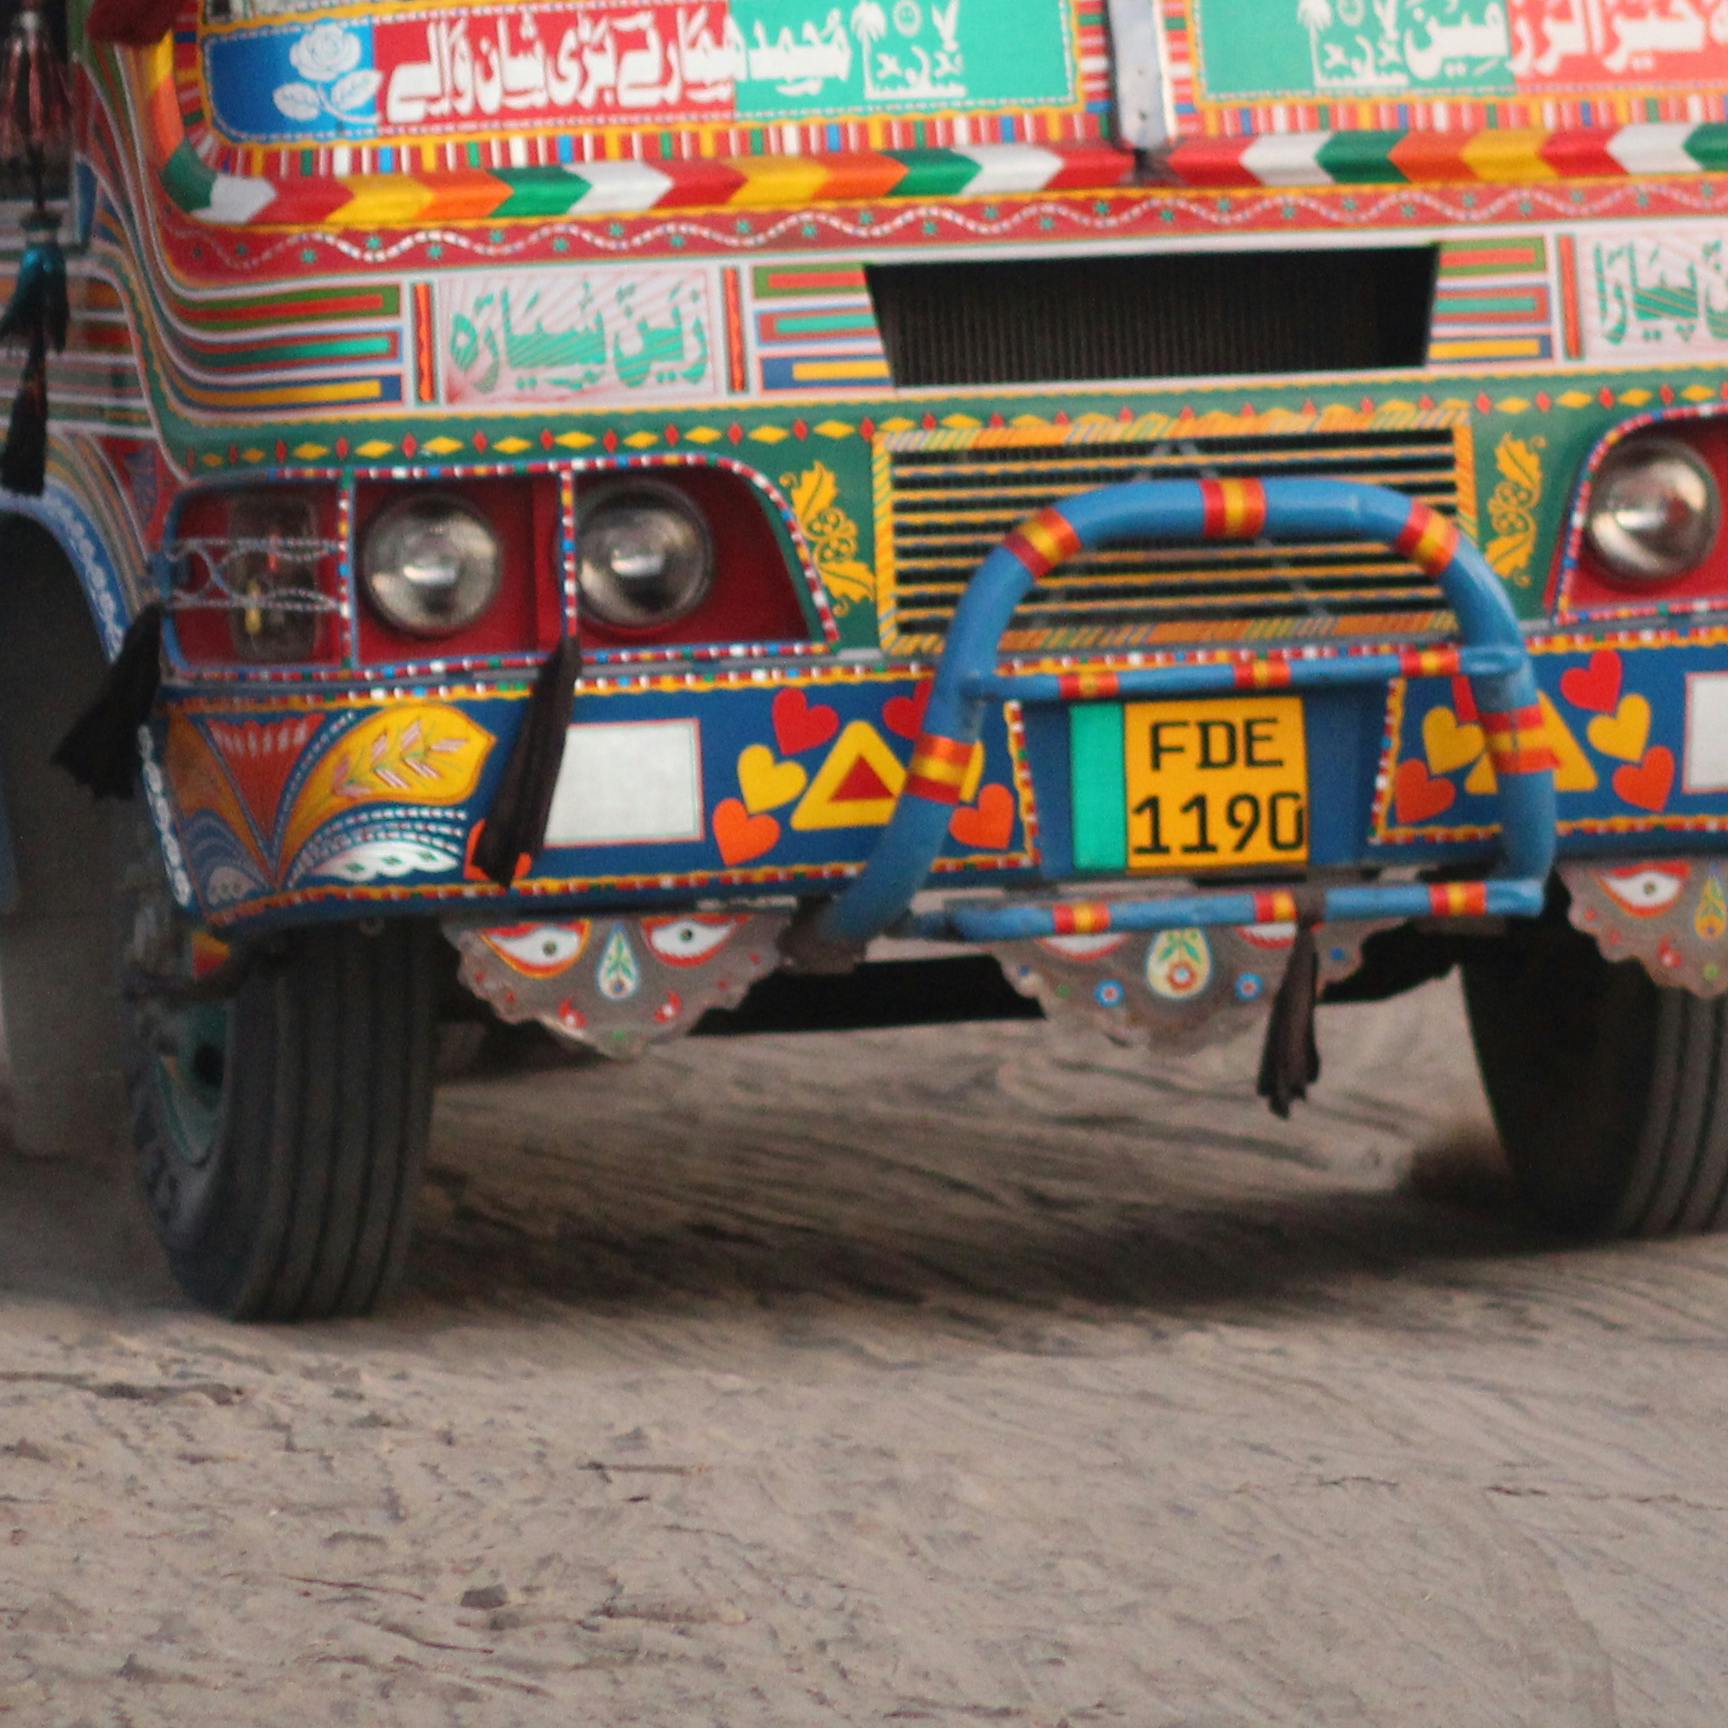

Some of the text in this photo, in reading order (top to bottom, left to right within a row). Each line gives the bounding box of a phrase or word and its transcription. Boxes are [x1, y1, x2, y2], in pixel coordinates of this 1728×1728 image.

[748, 7, 853, 96] محمد
[1149, 718, 1284, 771] FDE
[1132, 791, 1304, 855] 1190
